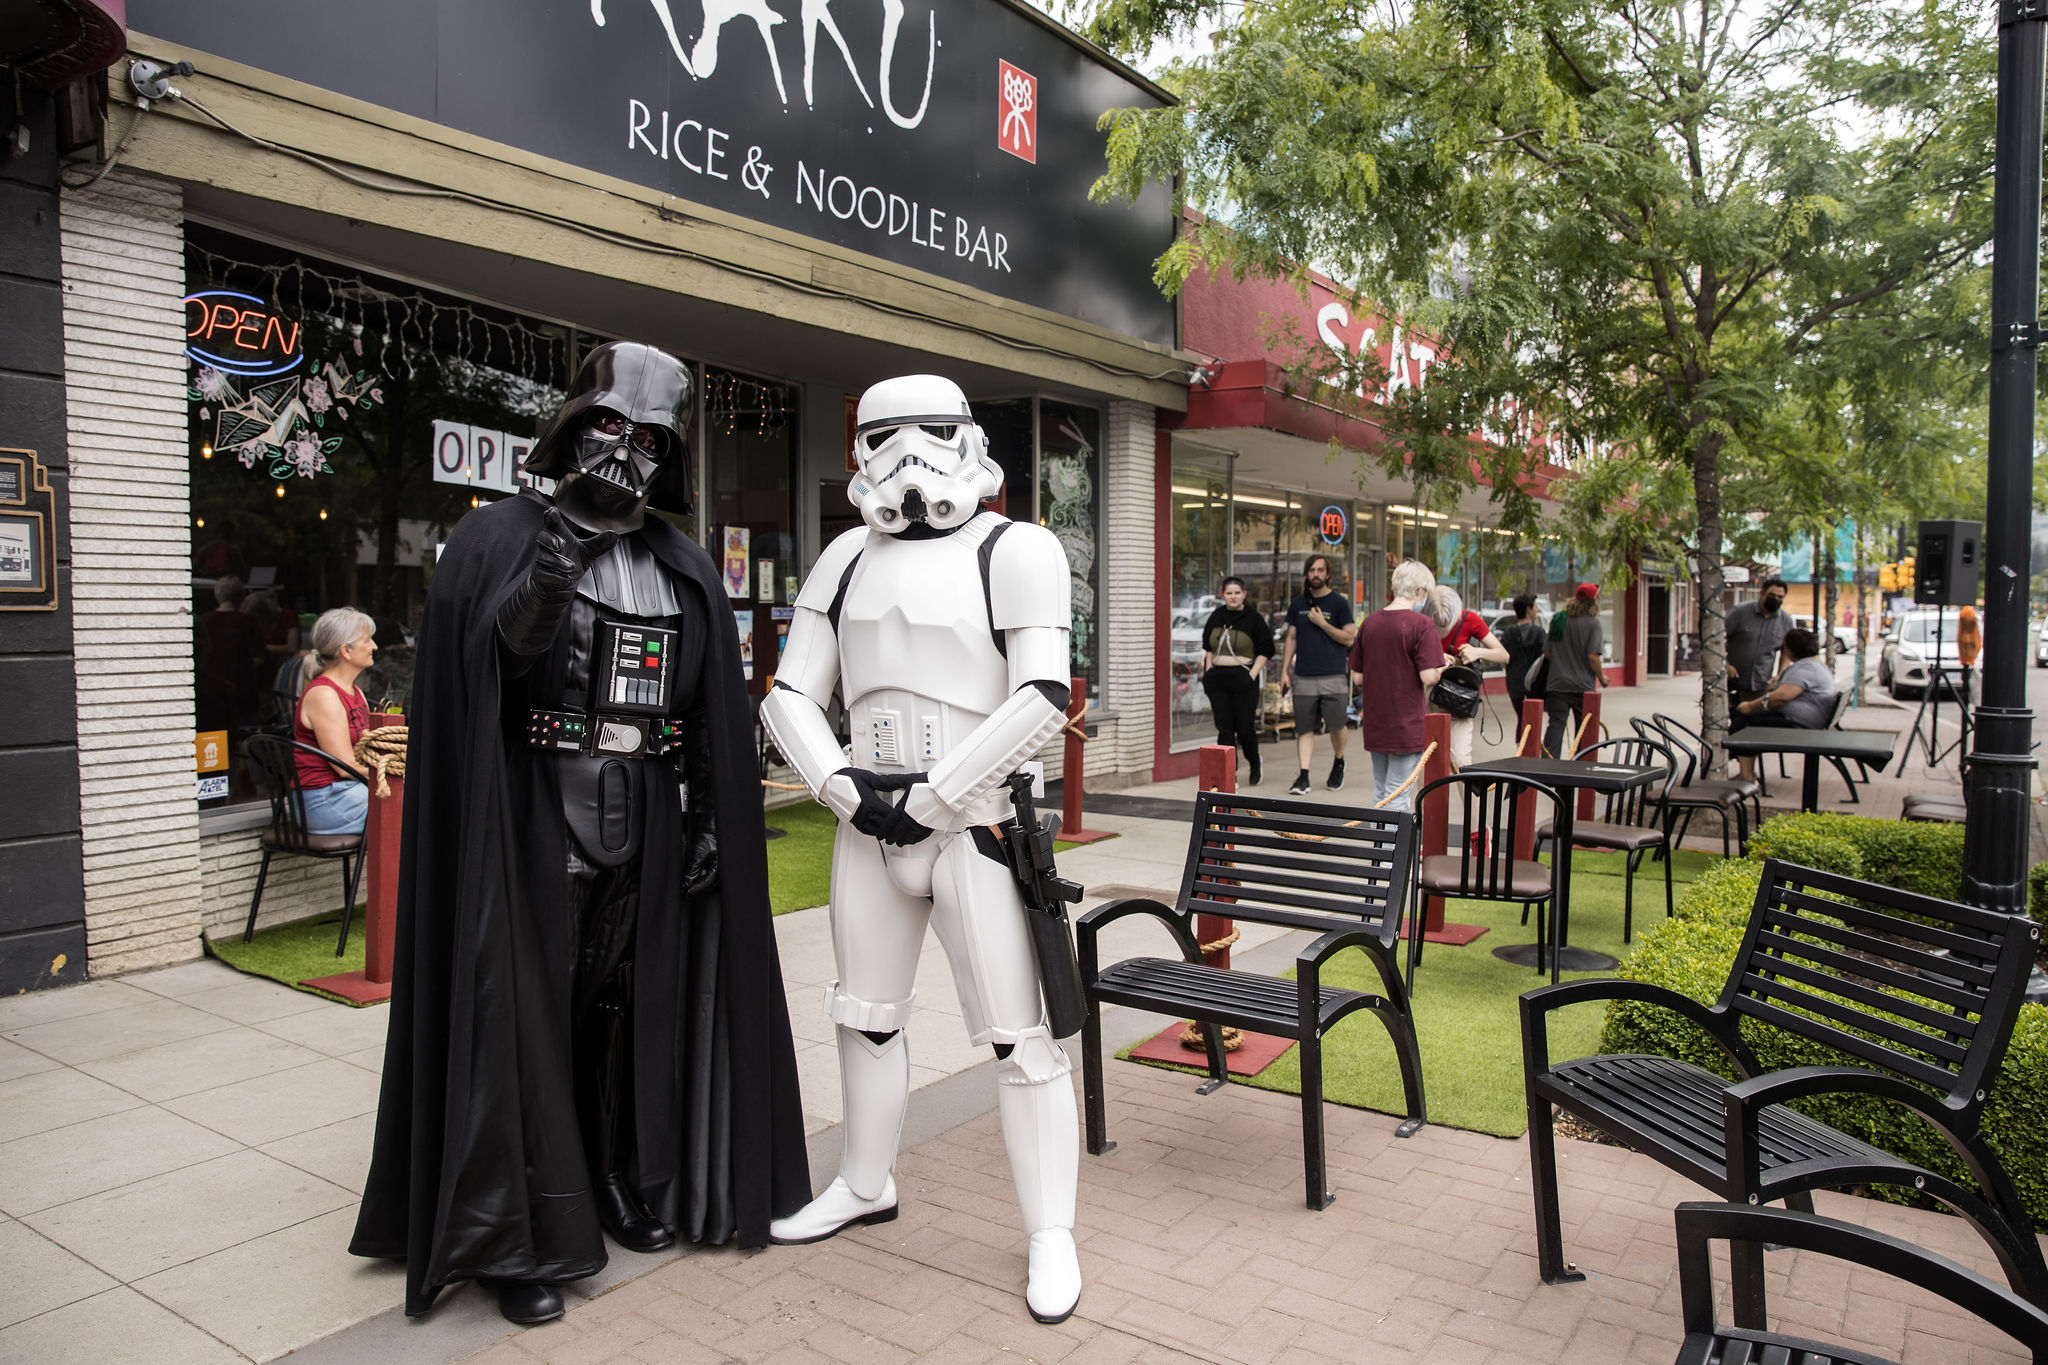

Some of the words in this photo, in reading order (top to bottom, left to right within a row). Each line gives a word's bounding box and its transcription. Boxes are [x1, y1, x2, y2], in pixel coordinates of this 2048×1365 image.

[628, 98, 729, 180] RICE
[741, 145, 773, 199] &
[796, 160, 945, 251] NOODLE
[955, 216, 1012, 273] BAR
[184, 298, 298, 355] OPEN
[439, 431, 544, 488] OPE
[1321, 513, 1343, 536] OPEN
